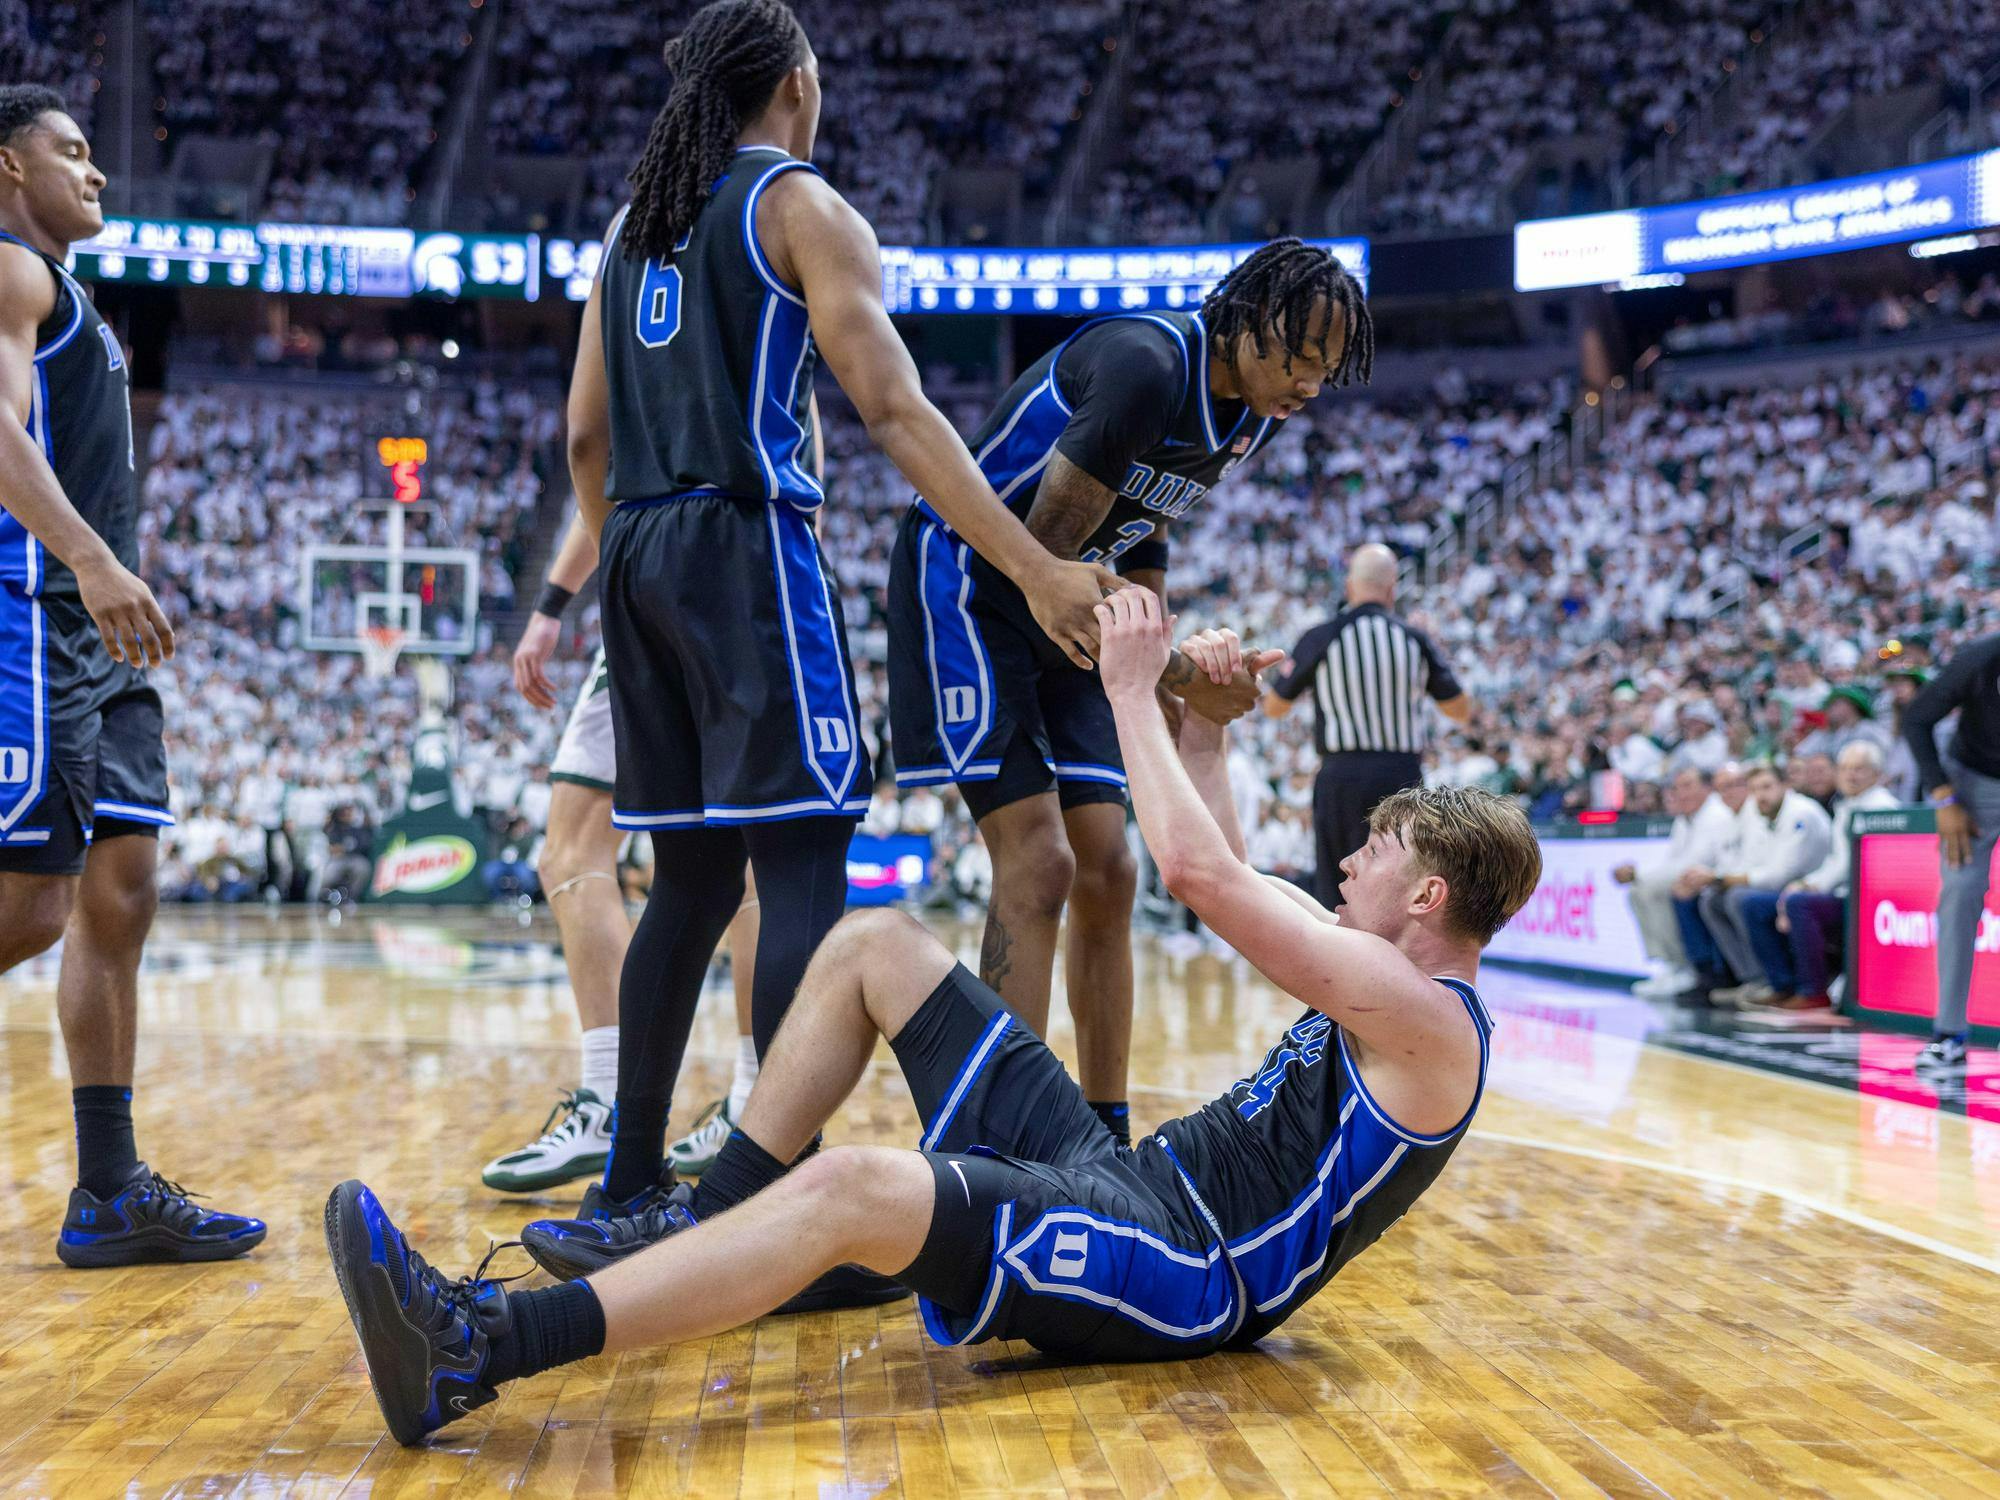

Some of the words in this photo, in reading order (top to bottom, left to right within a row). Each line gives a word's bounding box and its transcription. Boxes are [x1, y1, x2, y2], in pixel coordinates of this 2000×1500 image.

[471, 241, 526, 284] 53
[636, 226, 693, 349] 6
[1873, 899, 1930, 948] Own
